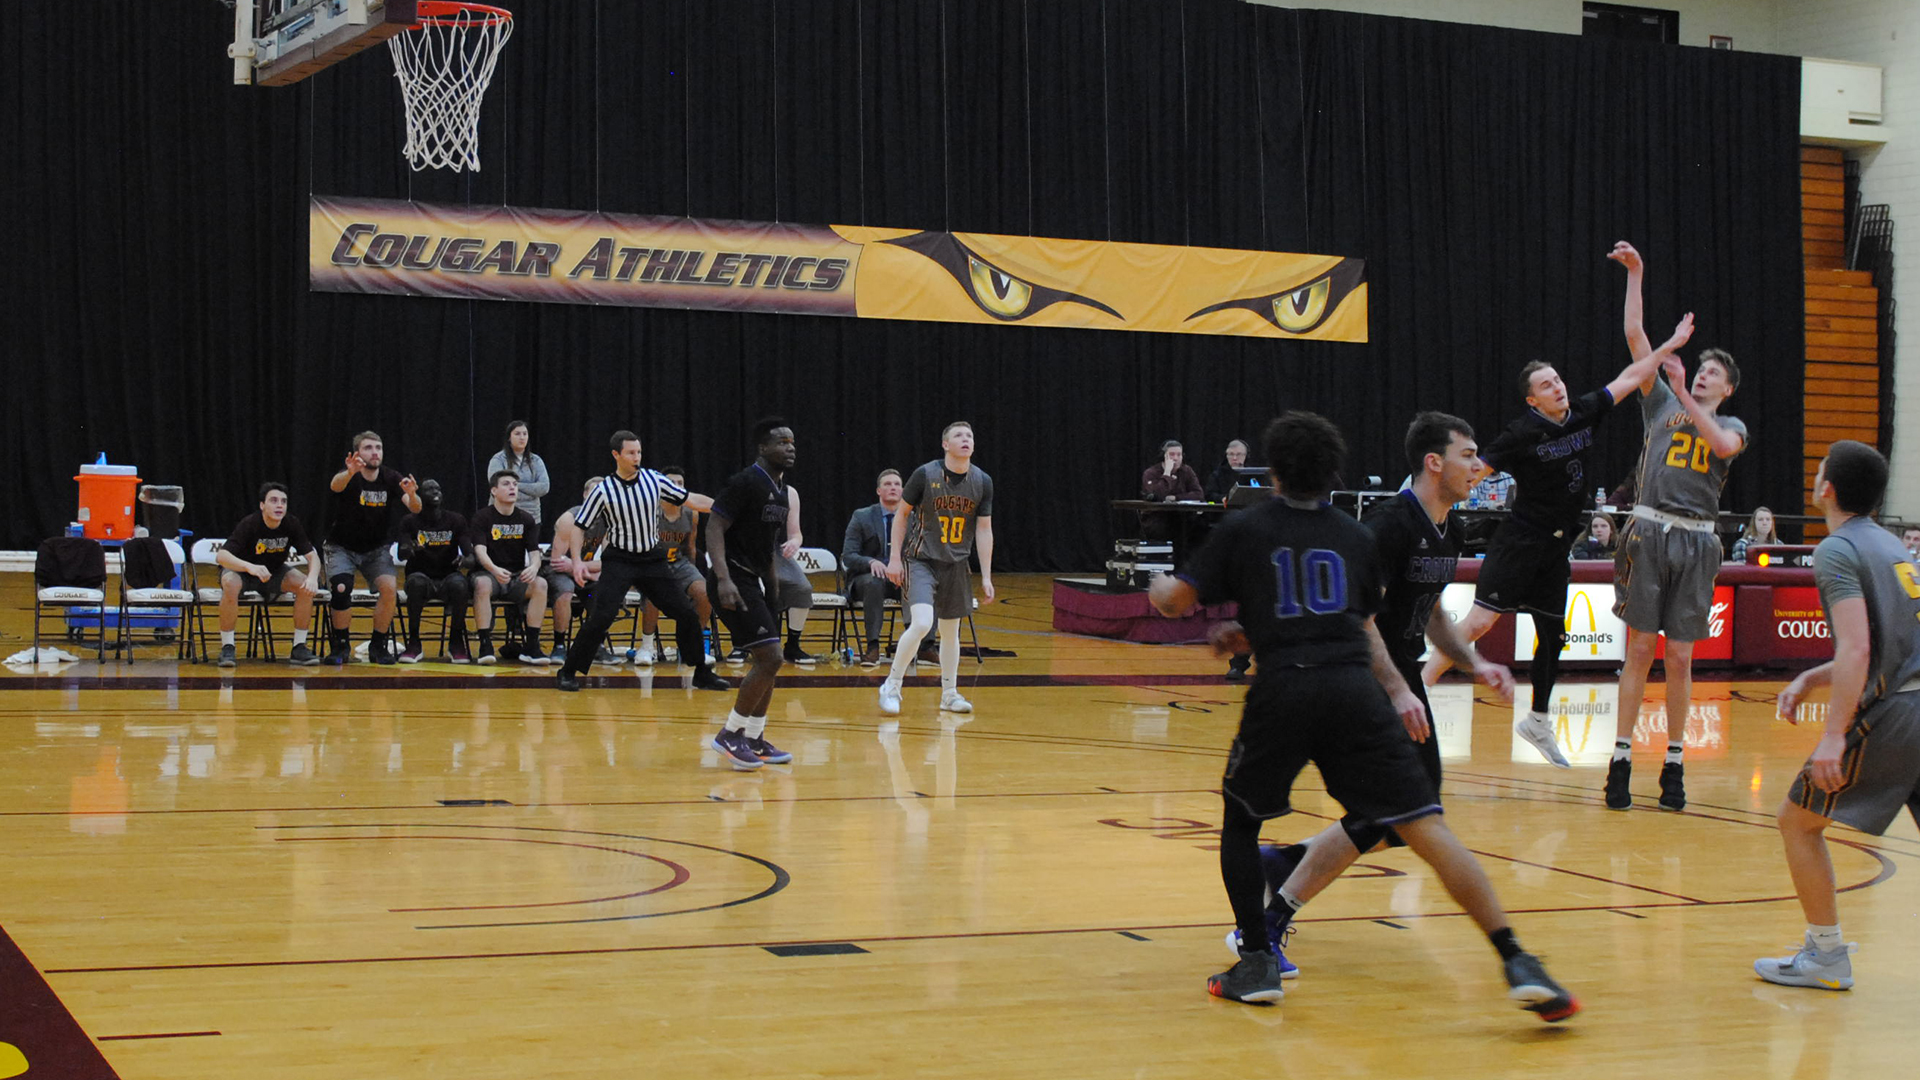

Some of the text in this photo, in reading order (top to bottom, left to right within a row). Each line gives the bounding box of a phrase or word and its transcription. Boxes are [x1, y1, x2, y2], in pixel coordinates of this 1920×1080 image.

[330, 222, 849, 291] COUGAR ATHLETICS
[1666, 431, 1711, 473] 20
[938, 515, 966, 543] 30
[1271, 547, 1347, 618] 10
[1406, 556, 1456, 583] CROW
[1563, 633, 1613, 643] Donald's
[1778, 620, 1831, 638] COUG
